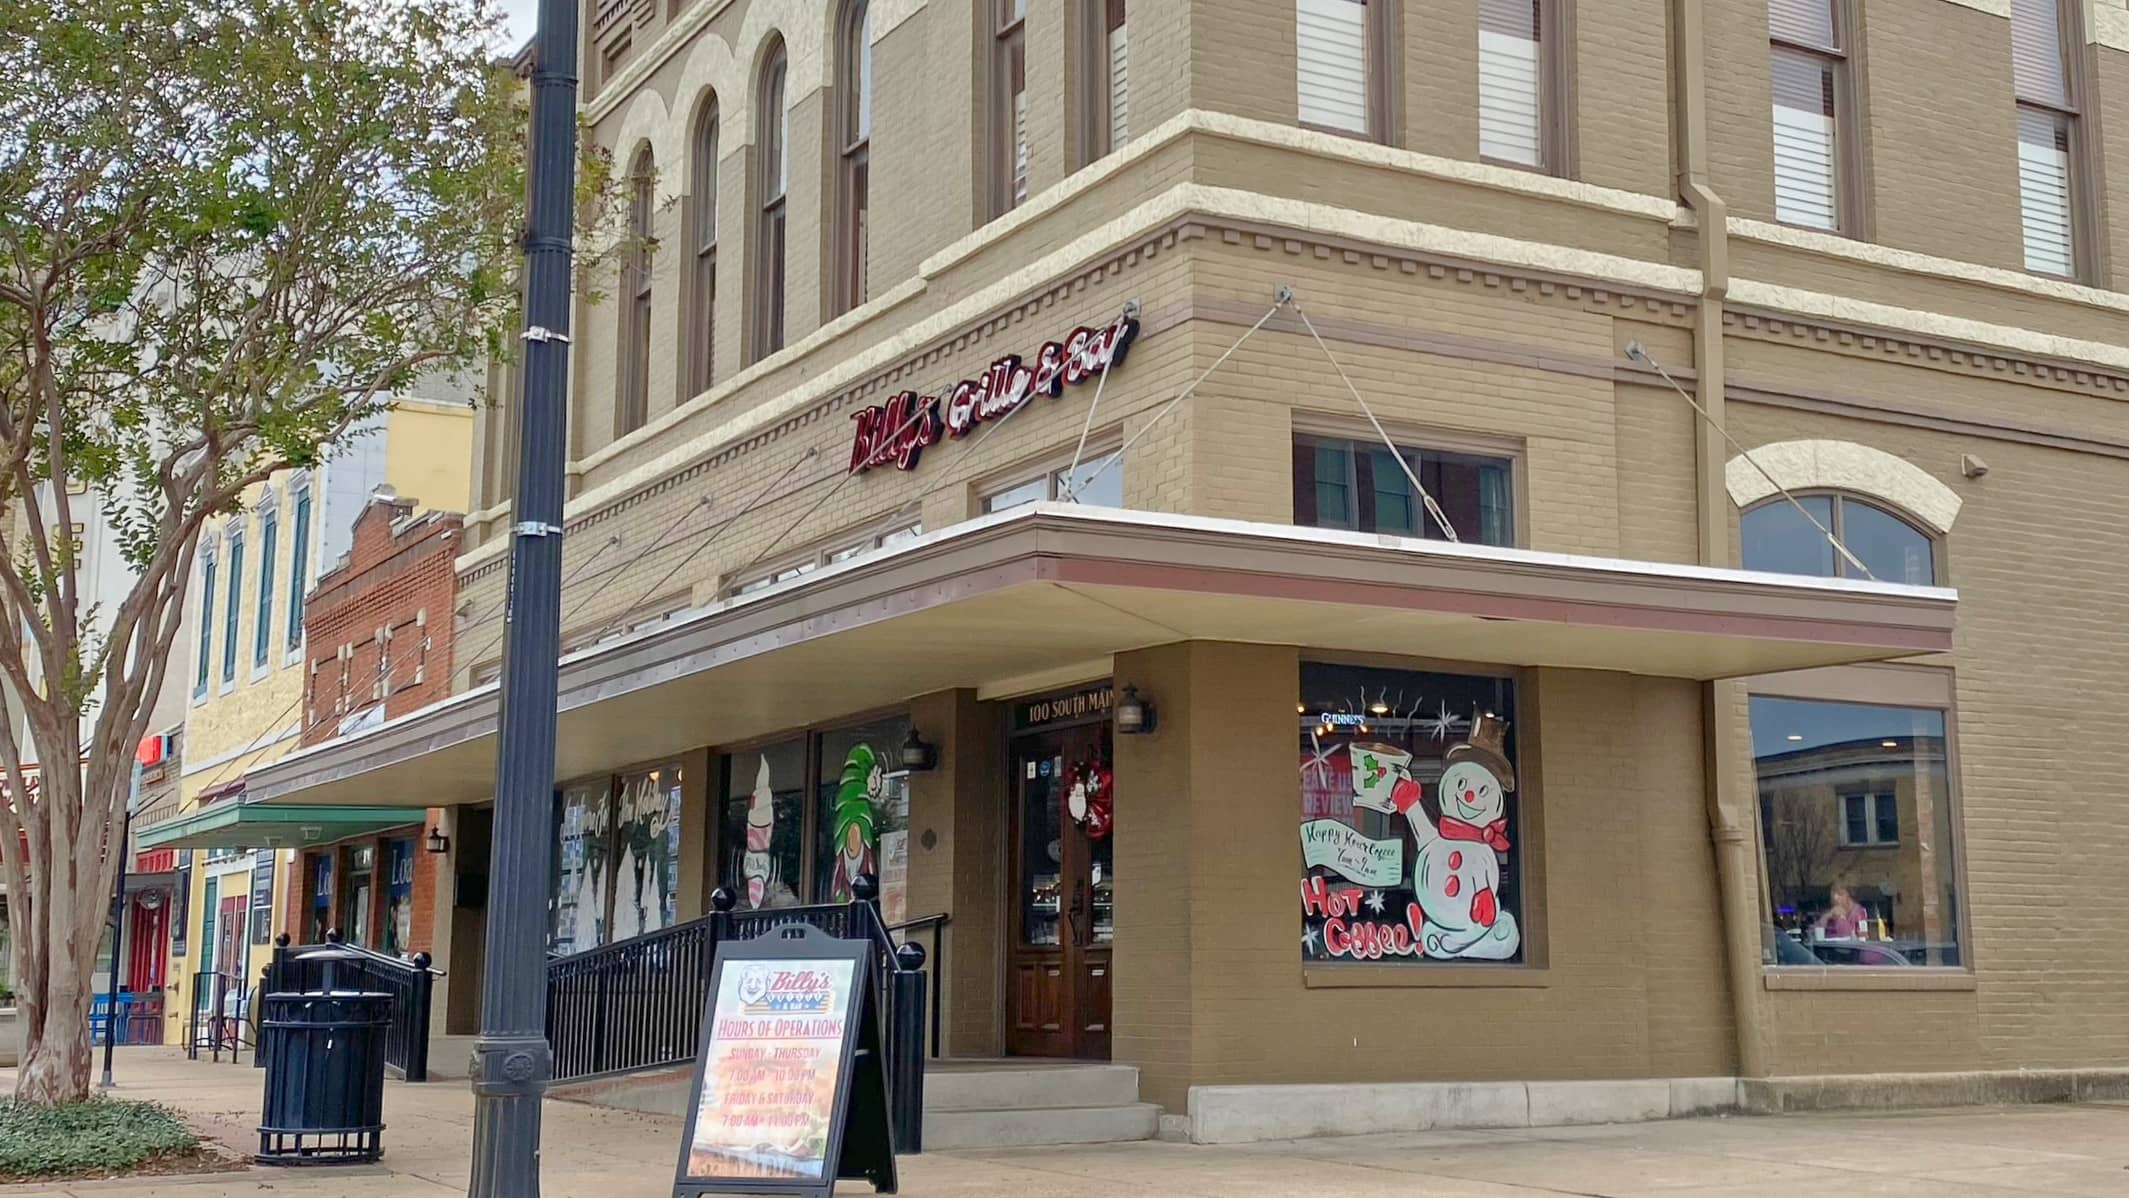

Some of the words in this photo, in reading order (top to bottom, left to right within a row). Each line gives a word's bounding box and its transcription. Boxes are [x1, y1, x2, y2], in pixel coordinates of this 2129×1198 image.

[850, 391, 944, 473] Billy's
[947, 354, 1034, 439] Grille
[1029, 341, 1063, 399] &
[1062, 317, 1140, 386] Bar
[1029, 703, 1049, 721] 100
[1051, 696, 1085, 718] SOUTH
[1305, 822, 1341, 845] Happy
[1344, 831, 1369, 855] Hour
[391, 849, 413, 885] Loa
[770, 970, 832, 994] Billy's
